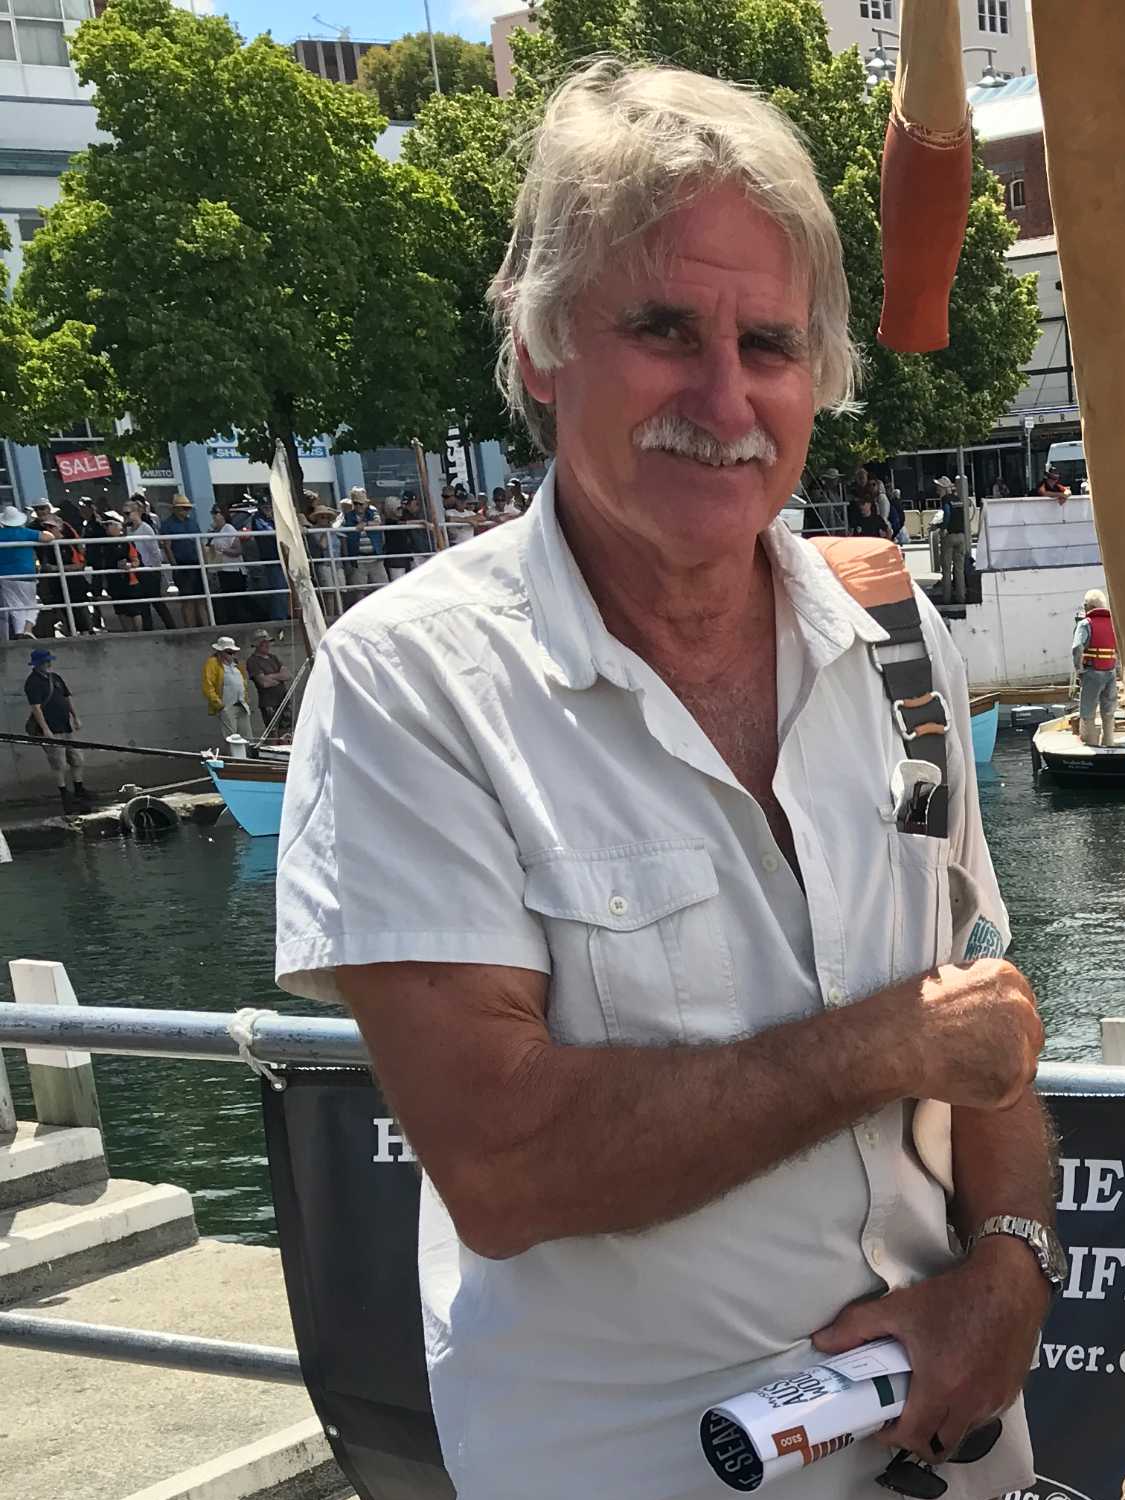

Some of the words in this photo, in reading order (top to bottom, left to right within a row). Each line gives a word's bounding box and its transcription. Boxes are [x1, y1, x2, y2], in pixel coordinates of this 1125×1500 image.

[60, 453, 110, 477] SALE
[142, 469, 173, 478] MUSTO
[780, 1434, 803, 1447] $3.00
